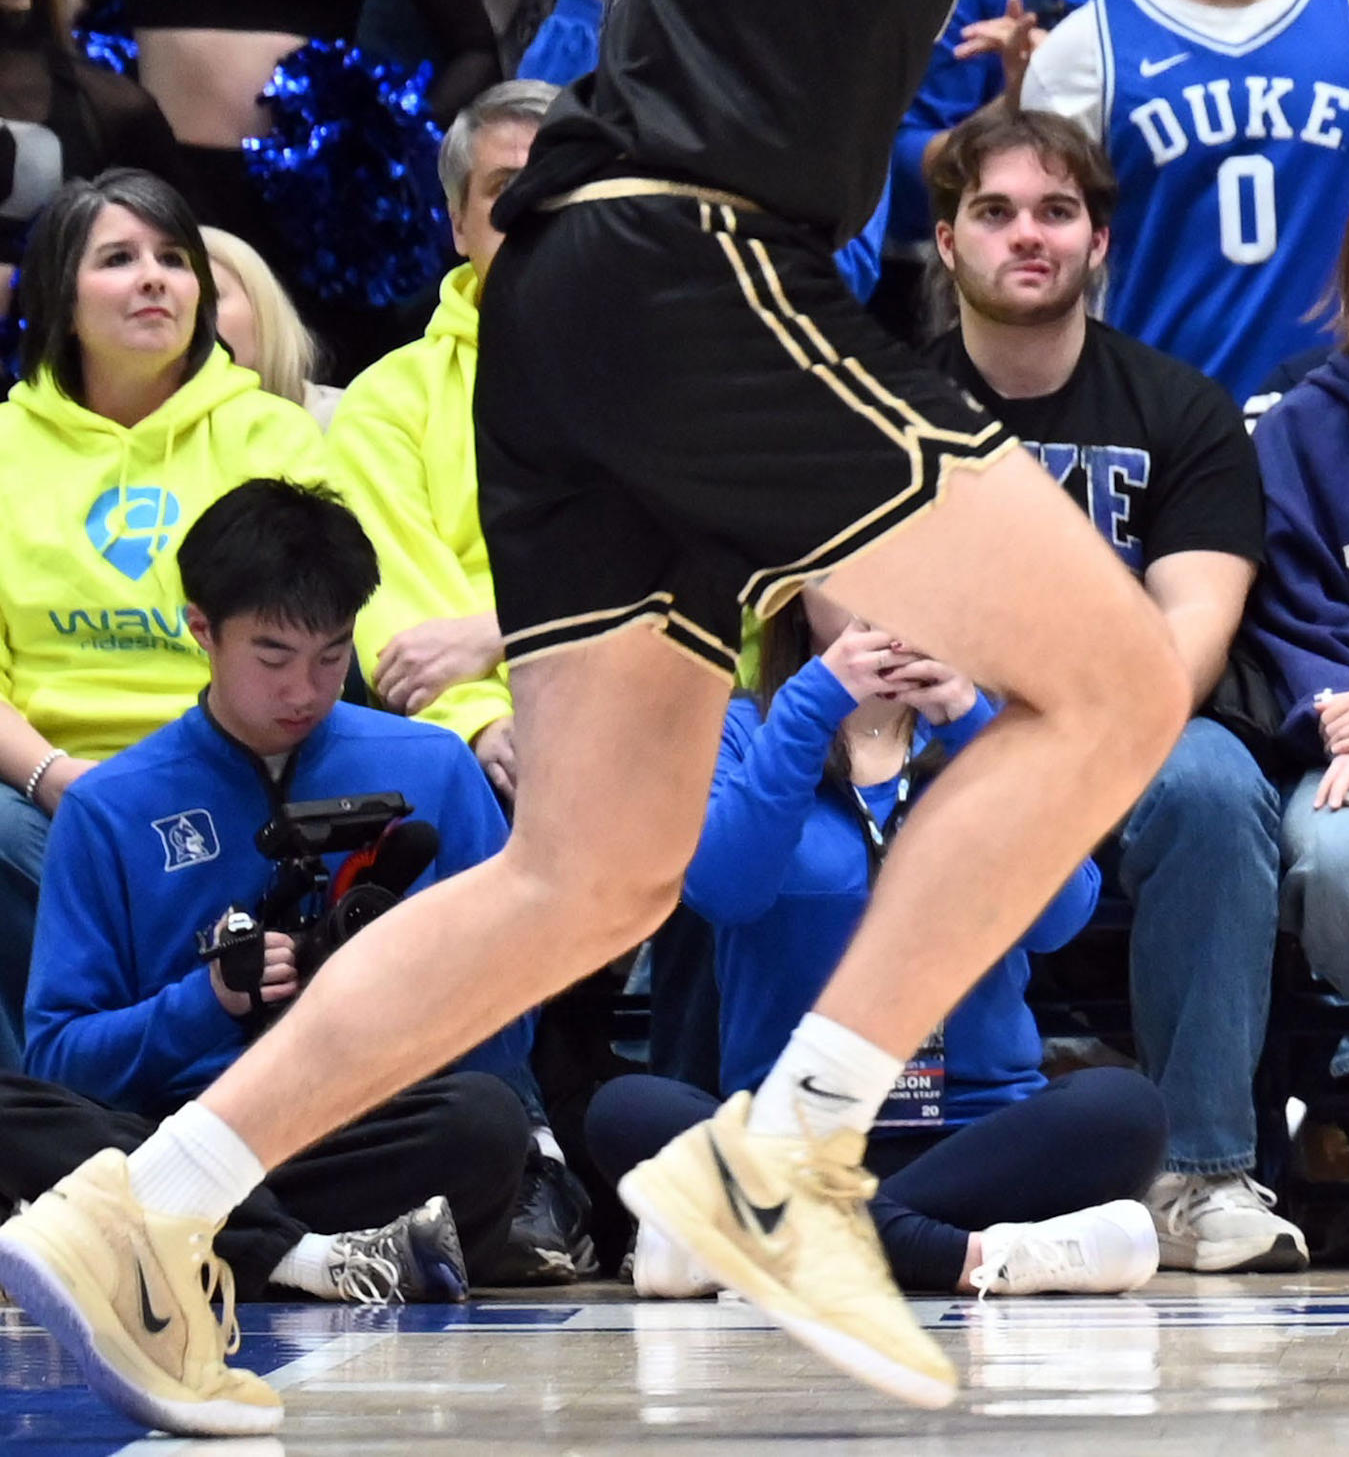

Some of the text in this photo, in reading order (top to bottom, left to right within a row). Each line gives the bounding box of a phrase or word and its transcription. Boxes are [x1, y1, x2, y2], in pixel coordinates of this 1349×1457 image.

[1217, 154, 1278, 266] 0
[895, 1075, 932, 1089] SON
[921, 1104, 940, 1117] 20
